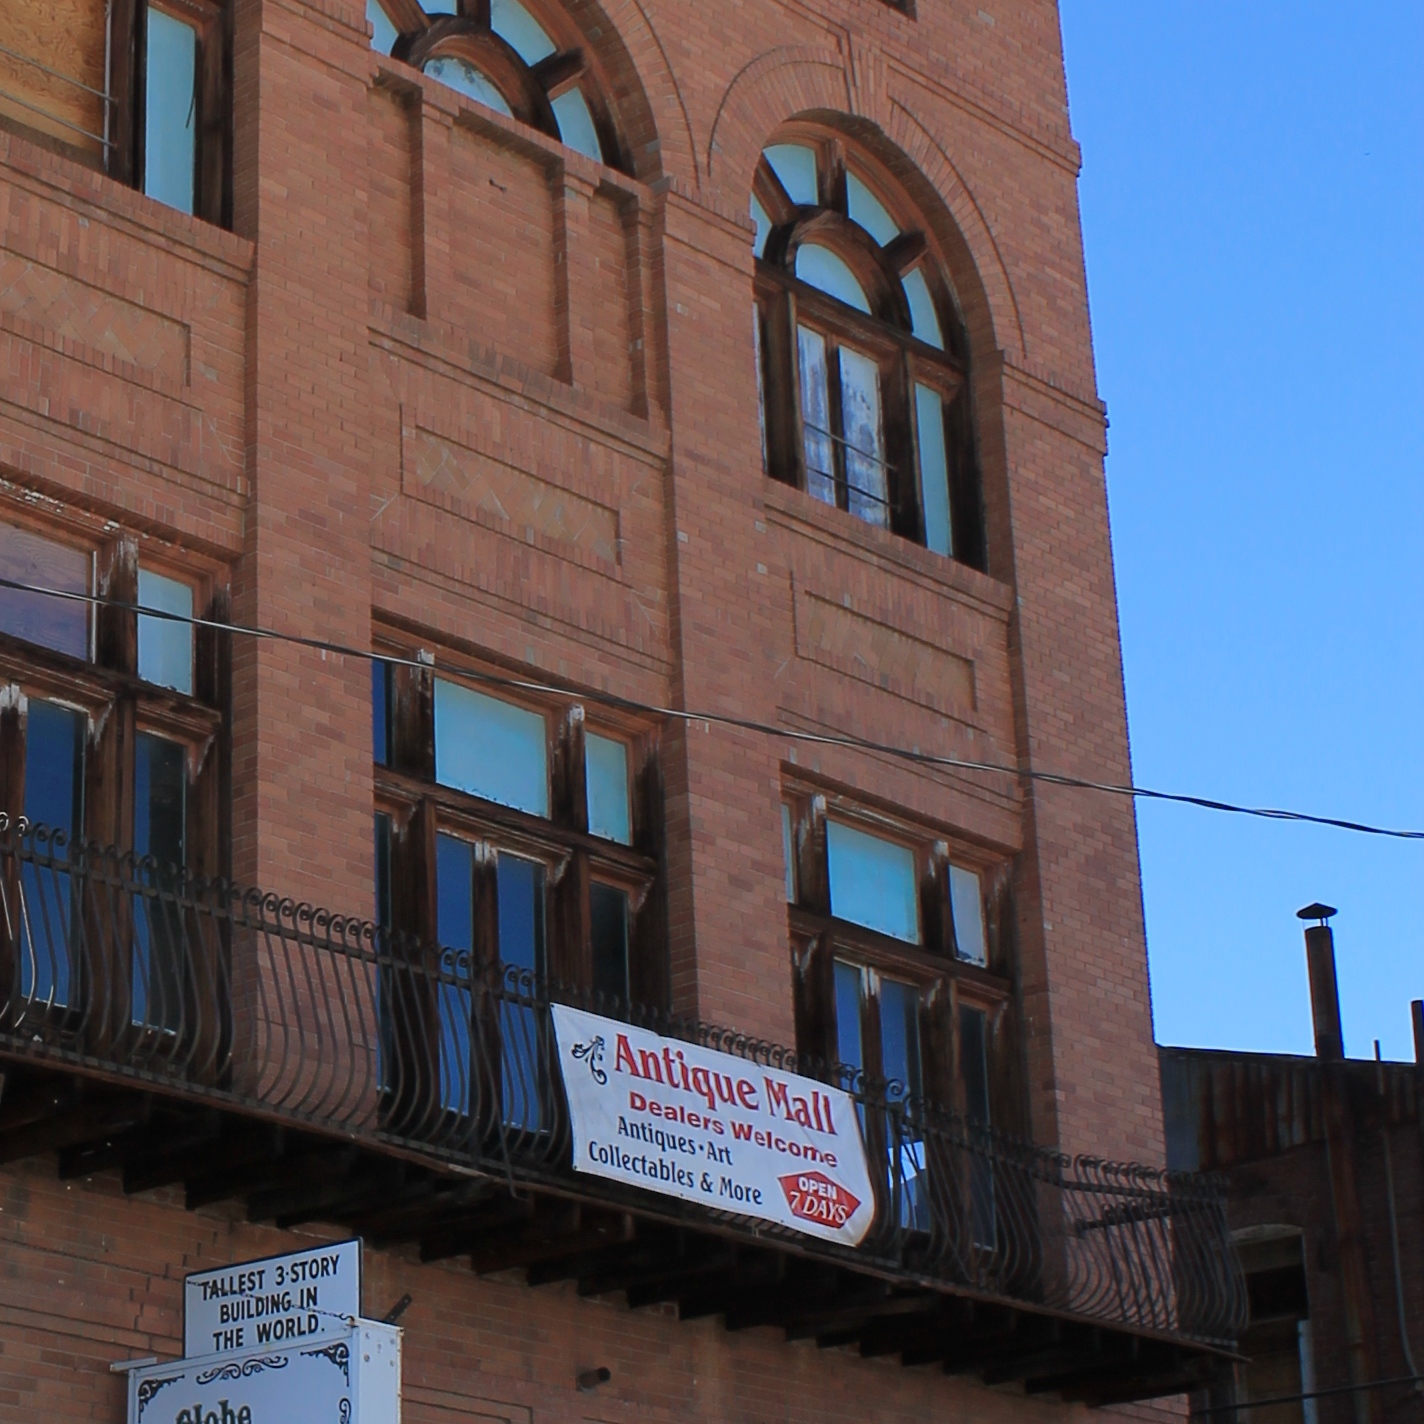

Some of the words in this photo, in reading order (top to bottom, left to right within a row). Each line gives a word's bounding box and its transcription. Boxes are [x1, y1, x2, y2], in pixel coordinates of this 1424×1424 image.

[615, 1033, 759, 1111] Antique
[763, 1076, 838, 1135] Mall
[629, 1091, 725, 1135] Dealers
[730, 1120, 839, 1168] Welcome
[588, 1140, 695, 1189] Collectables
[700, 1172, 713, 1194] &
[719, 1176, 764, 1206] More
[798, 1176, 837, 1200] OPEN
[789, 1190, 802, 1210] 7
[802, 1195, 850, 1225] DAYS
[201, 1270, 266, 1301] TALLEST
[220, 1291, 292, 1325] BUILDING
[299, 1286, 318, 1310] IN
[213, 1327, 244, 1352] THE
[257, 1313, 325, 1344] WORLD.
